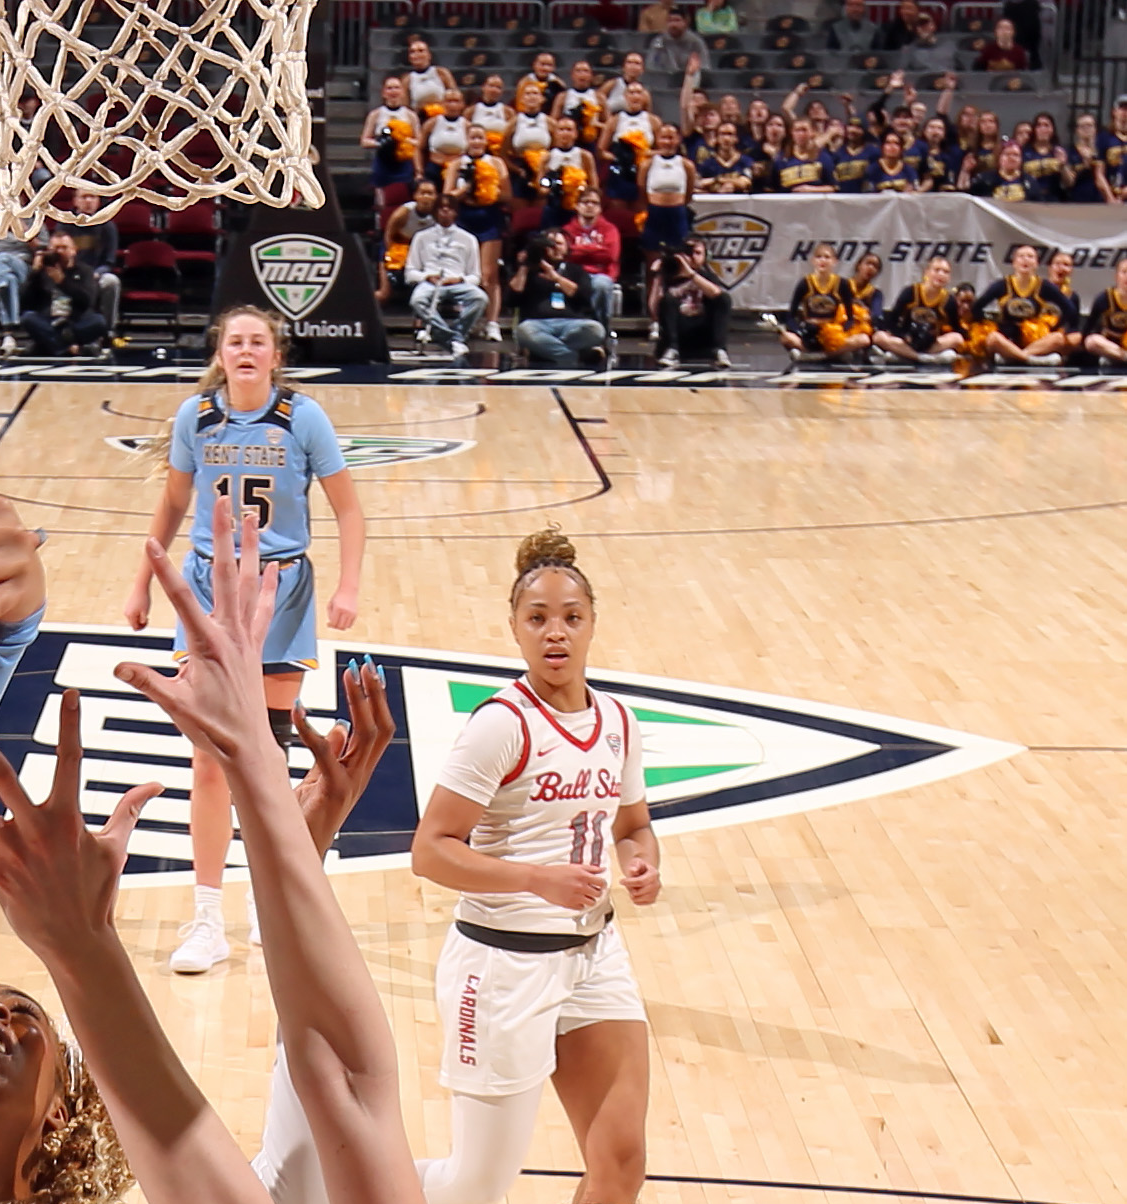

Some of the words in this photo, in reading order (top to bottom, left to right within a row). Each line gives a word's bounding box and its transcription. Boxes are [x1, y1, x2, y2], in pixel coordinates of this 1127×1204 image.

[888, 241, 995, 263] STATE
[262, 262, 333, 282] MAC
[203, 444, 241, 466] KENT
[243, 445, 286, 468] STATE
[213, 474, 274, 532] 15
[530, 769, 591, 801] Ball
[569, 810, 607, 866] 11
[458, 973, 481, 1067] CARDINALS
